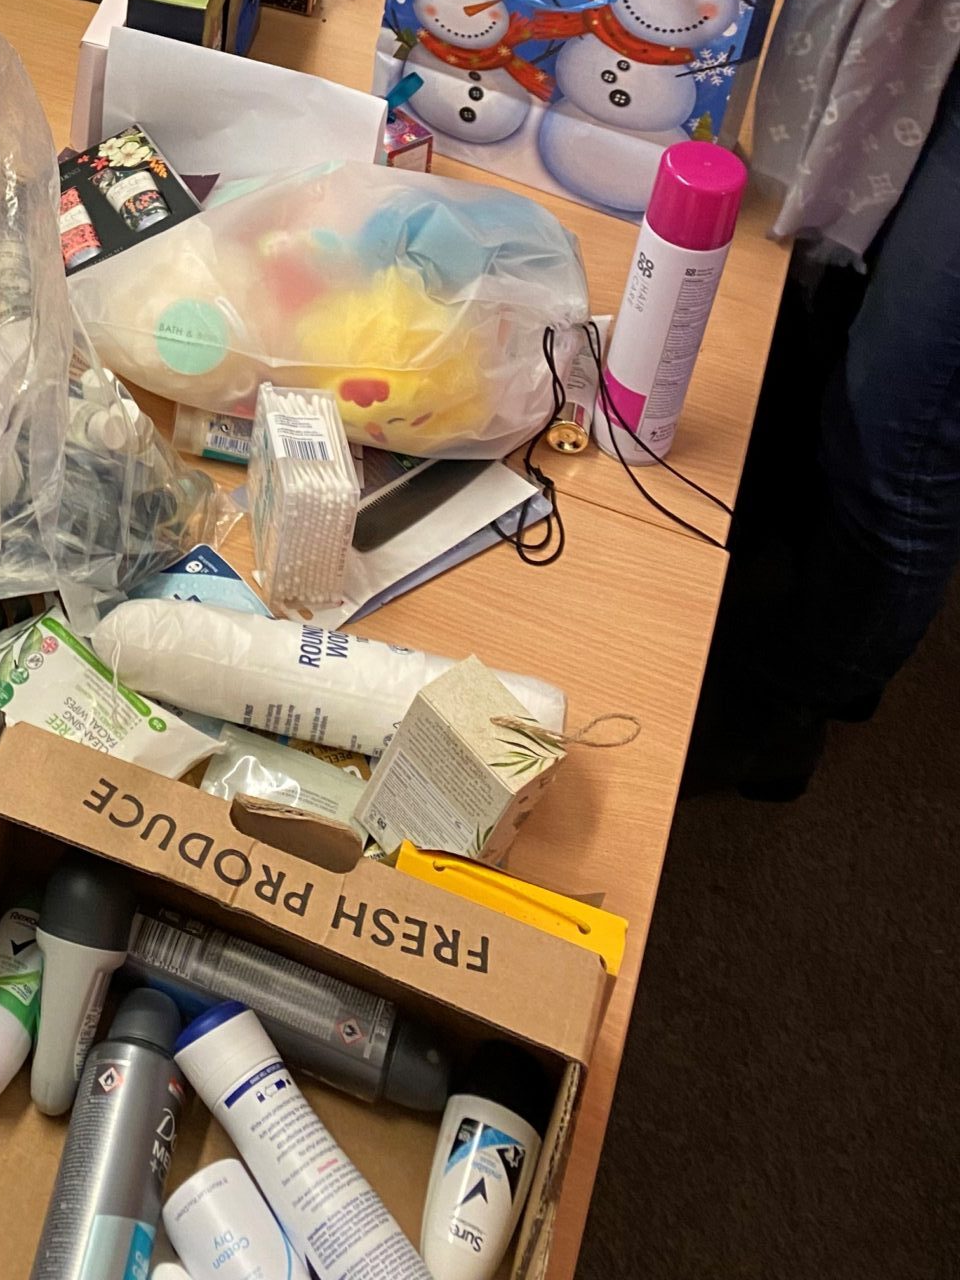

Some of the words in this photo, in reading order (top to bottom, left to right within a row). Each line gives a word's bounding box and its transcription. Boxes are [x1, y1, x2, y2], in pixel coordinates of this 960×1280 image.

[159, 323, 183, 336] BATH
[326, 631, 350, 659] WOO
[63, 696, 90, 721] WIPES
[61, 710, 111, 756] CLEANSING
[87, 718, 119, 749] FACIAL
[327, 750, 353, 765] PEEL
[82, 778, 314, 917] PRODUCE
[331, 895, 491, 974] FRESH
[152, 1140, 172, 1170] ME
[212, 1236, 250, 1270] Cotton
[214, 1230, 234, 1249] Dry
[450, 1224, 484, 1253] Sure
